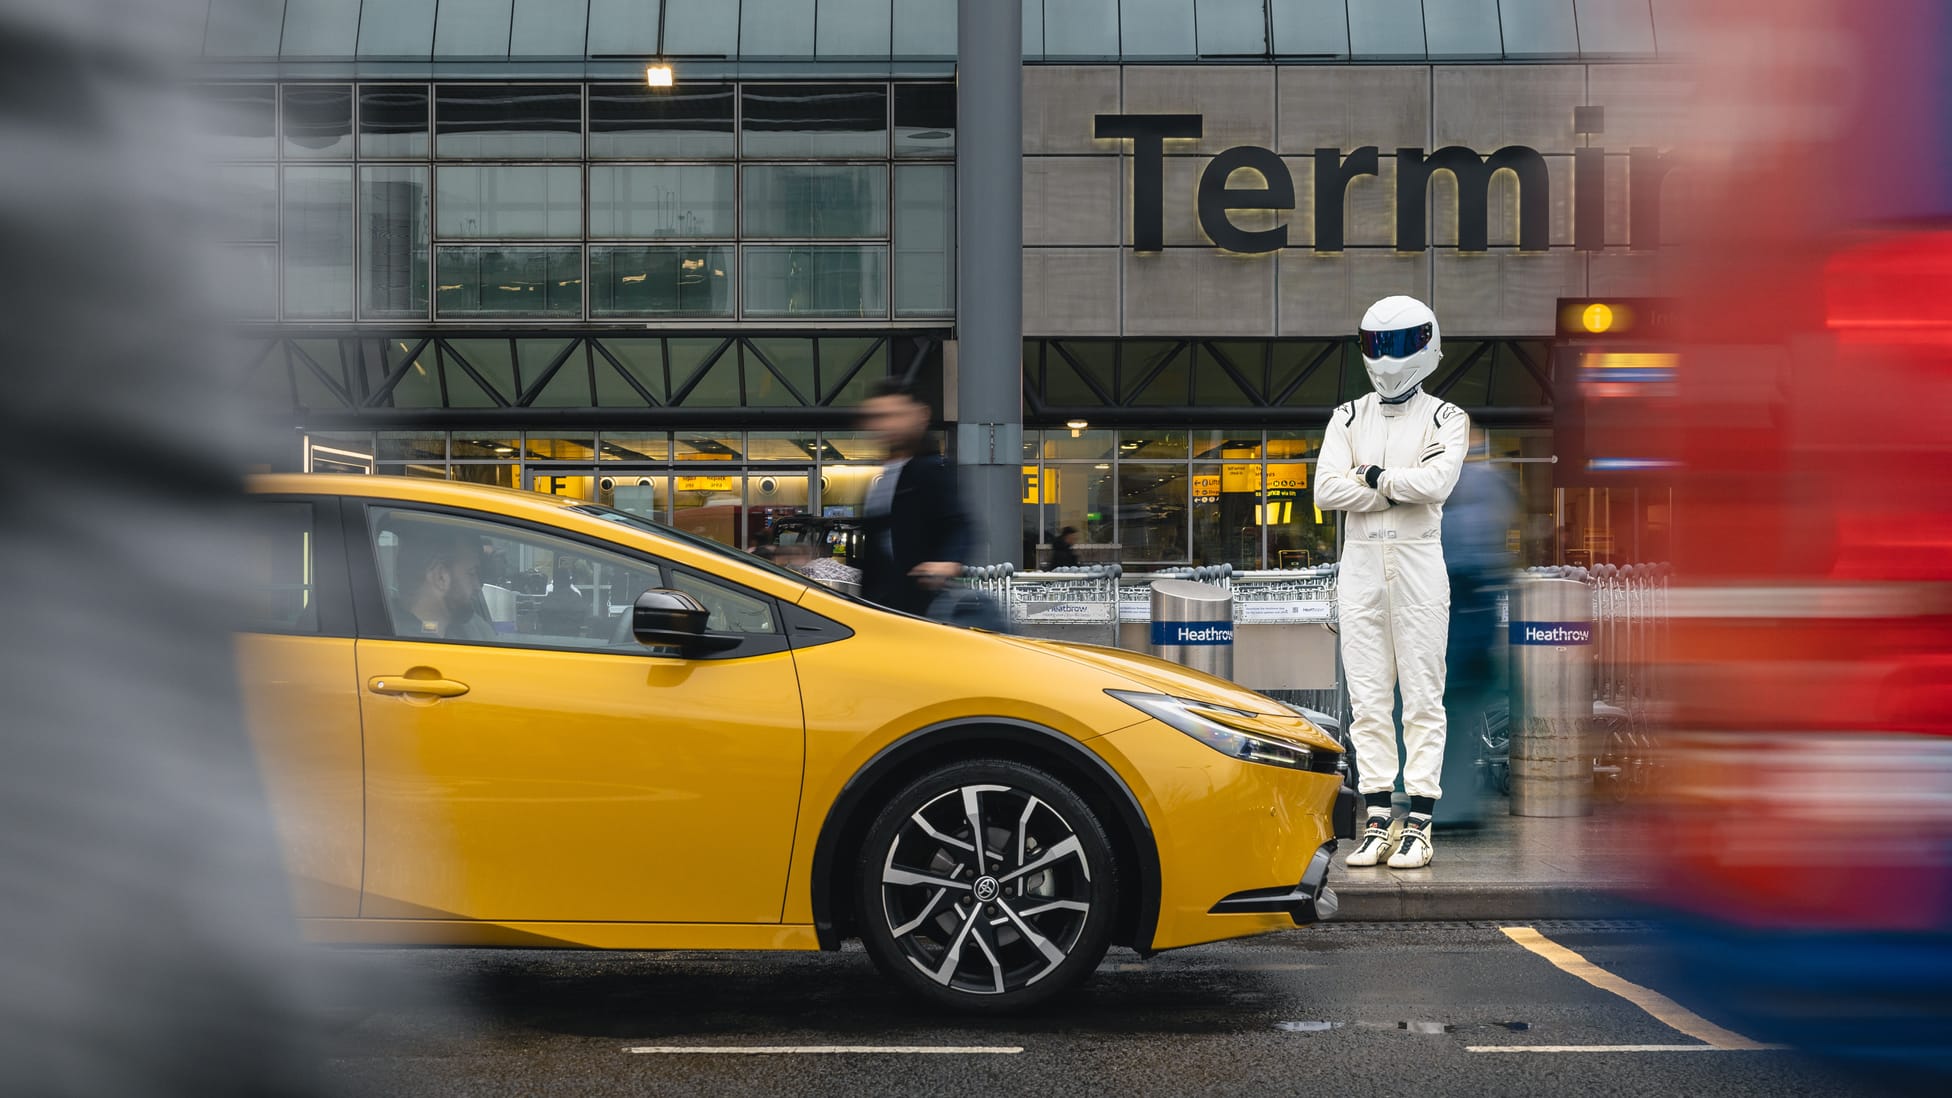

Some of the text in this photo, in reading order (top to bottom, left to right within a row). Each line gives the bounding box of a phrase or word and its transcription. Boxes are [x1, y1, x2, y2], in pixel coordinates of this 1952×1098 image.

[1023, 473, 1038, 499] F
[1177, 626, 1234, 641] Heathrow
[1525, 626, 1590, 641] Heathrow
